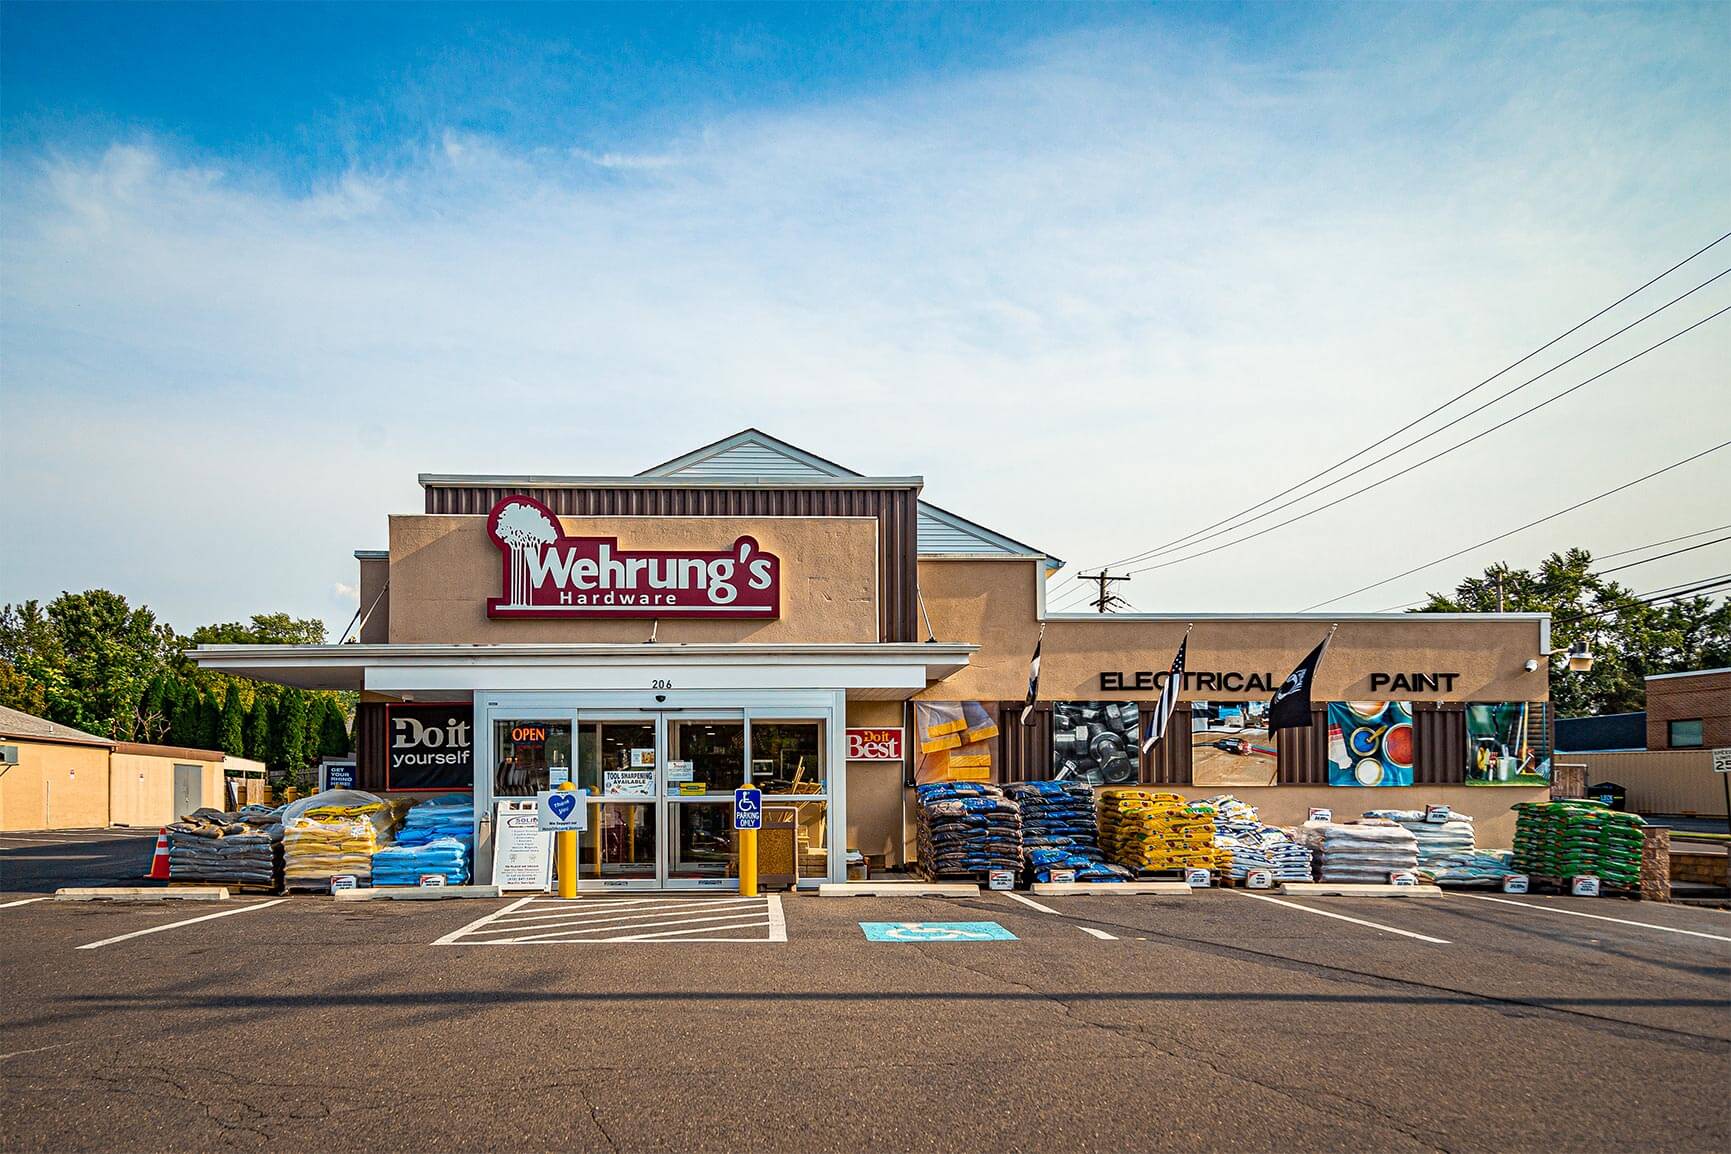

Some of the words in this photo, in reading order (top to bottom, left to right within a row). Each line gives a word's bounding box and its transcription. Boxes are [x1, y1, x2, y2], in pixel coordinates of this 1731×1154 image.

[523, 543, 772, 605] Wehrung's
[559, 591, 677, 605] Hardware
[651, 679, 672, 689] 206
[1370, 672, 1460, 692] PAINT
[392, 717, 444, 749] Do
[445, 718, 471, 748] it
[511, 727, 545, 742] OPEN
[863, 730, 881, 742] Do
[881, 730, 890, 742] it
[846, 734, 899, 759] Best
[392, 750, 471, 768] yourself
[606, 772, 620, 780] TOOL
[621, 771, 653, 780] SHARPENING
[736, 811, 760, 820] PARKING
[740, 819, 756, 827] ONLY
